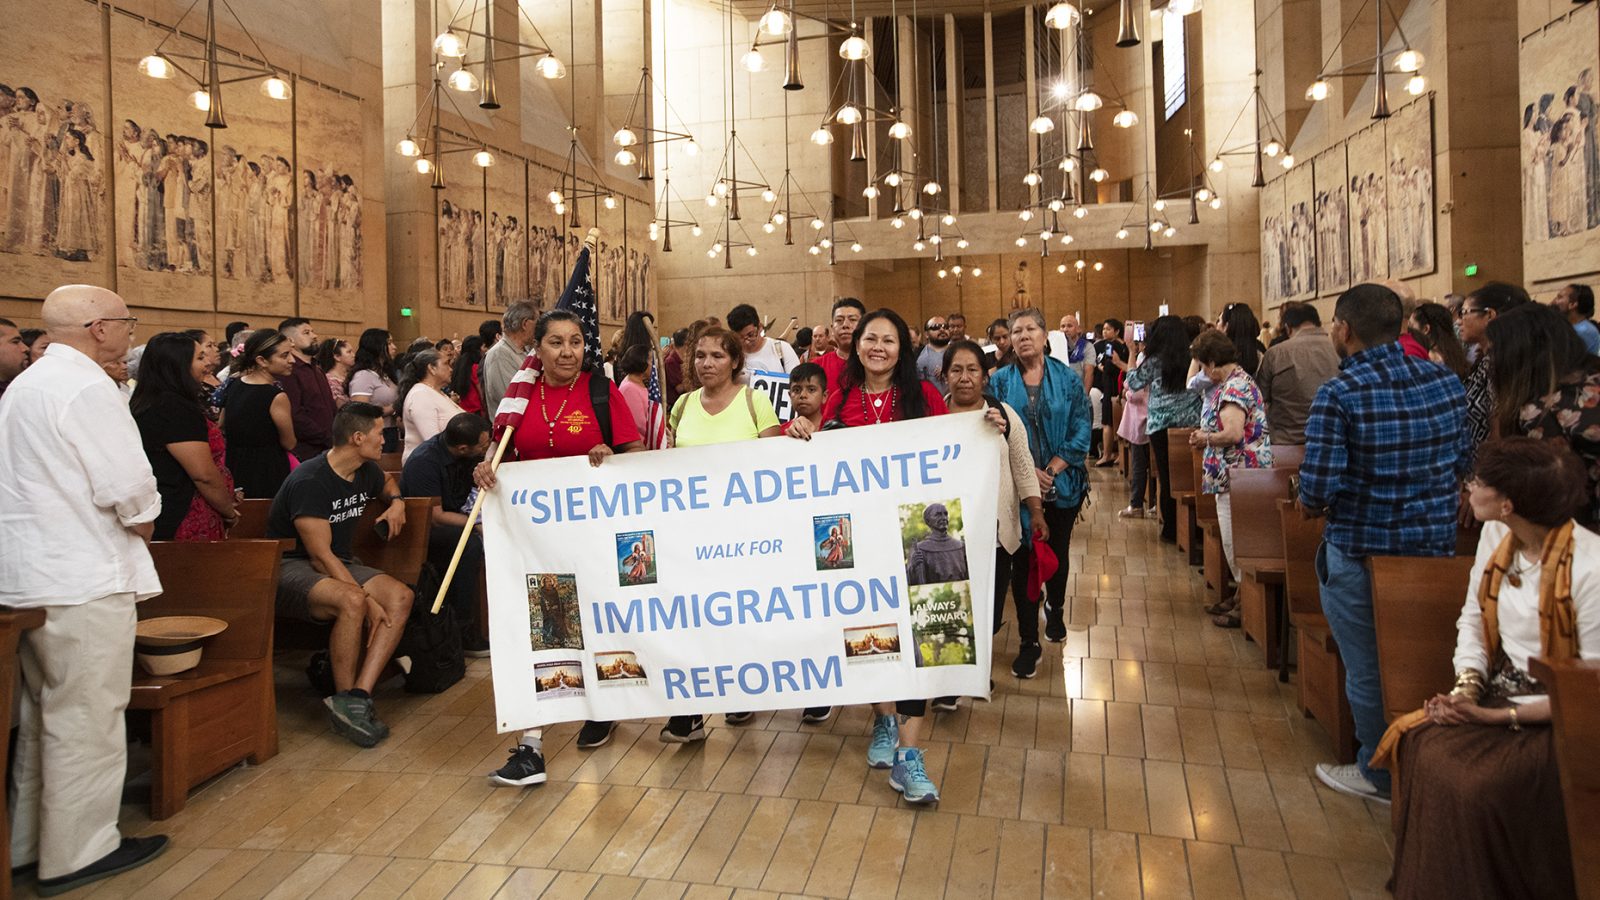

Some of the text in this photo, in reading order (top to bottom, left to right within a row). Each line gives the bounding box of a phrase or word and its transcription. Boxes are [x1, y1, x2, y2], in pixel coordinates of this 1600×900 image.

[511, 443, 961, 524] “SIEMPRE ADELANTE”
[695, 539, 783, 561] WALK FOR
[591, 575, 900, 634] IMMIGRATION
[663, 655, 843, 699] REFORM
